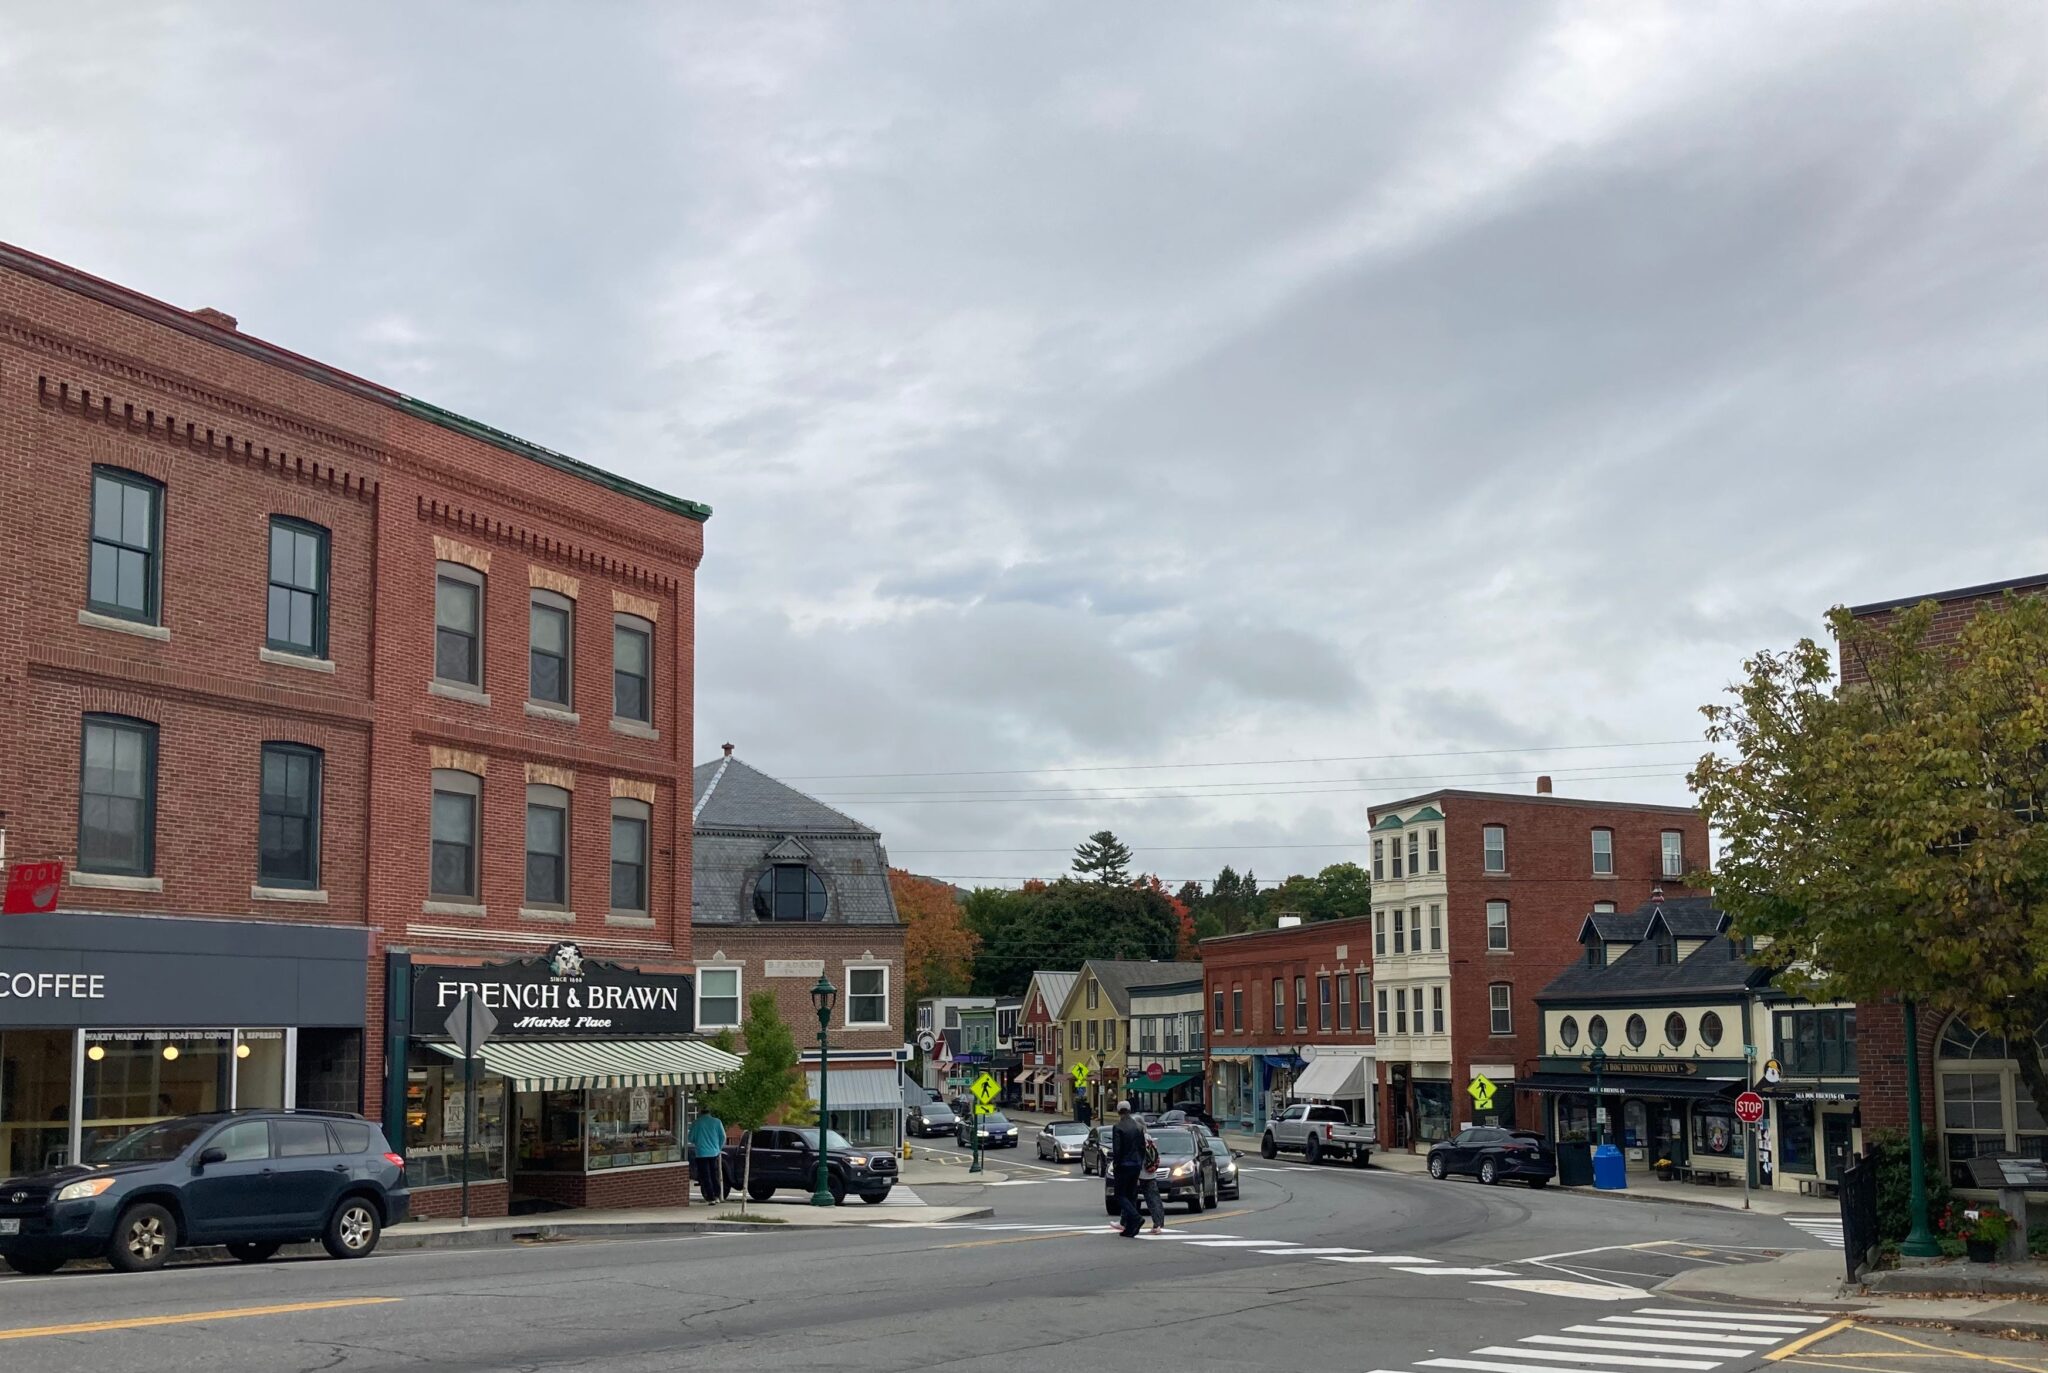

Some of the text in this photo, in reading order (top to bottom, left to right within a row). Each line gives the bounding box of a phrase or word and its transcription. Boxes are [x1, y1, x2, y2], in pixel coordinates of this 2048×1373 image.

[0, 972, 105, 999] COFFEE
[566, 987, 582, 1008] &
[588, 986, 678, 1012] BRAWN
[513, 1016, 612, 1029] Market Place
[1609, 1063, 1621, 1072] DOG
[1622, 1063, 1649, 1072] BREWING
[1650, 1063, 1678, 1073] COMPANY
[1737, 1101, 1762, 1114] STOP
[405, 1146, 428, 1154] Custom
[429, 1144, 442, 1153] Cut
